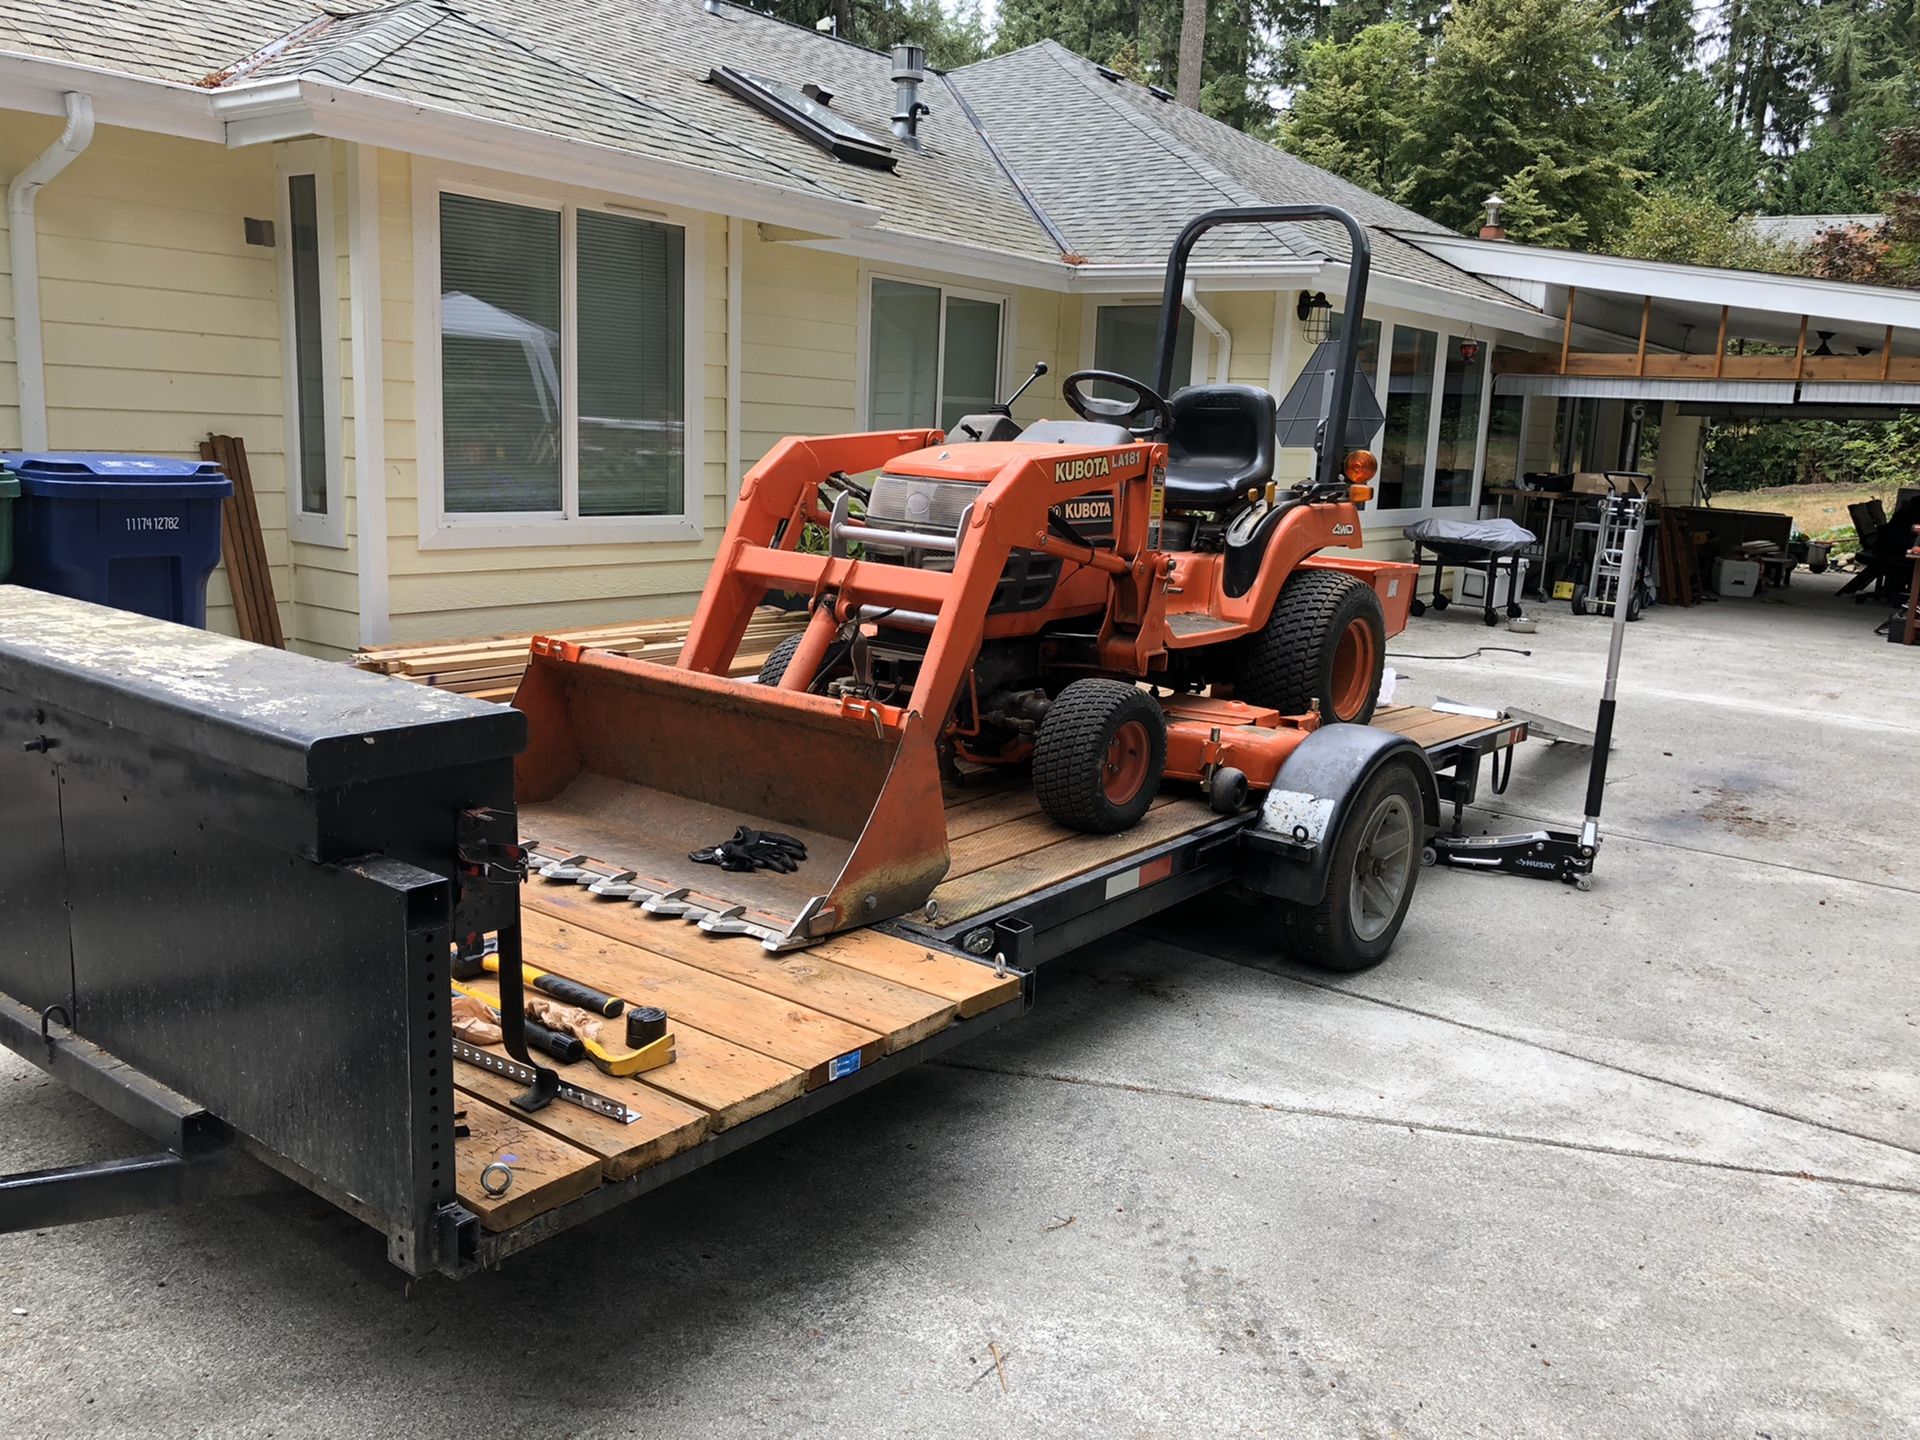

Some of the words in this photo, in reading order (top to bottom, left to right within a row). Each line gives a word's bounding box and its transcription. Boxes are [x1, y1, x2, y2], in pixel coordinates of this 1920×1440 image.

[1055, 456, 1110, 482] KUBOTA
[1112, 451, 1141, 468] LA181
[1065, 501, 1112, 519] KUBOTA
[1332, 523, 1354, 535] 4WD
[1526, 860, 1556, 870] HUSKY
